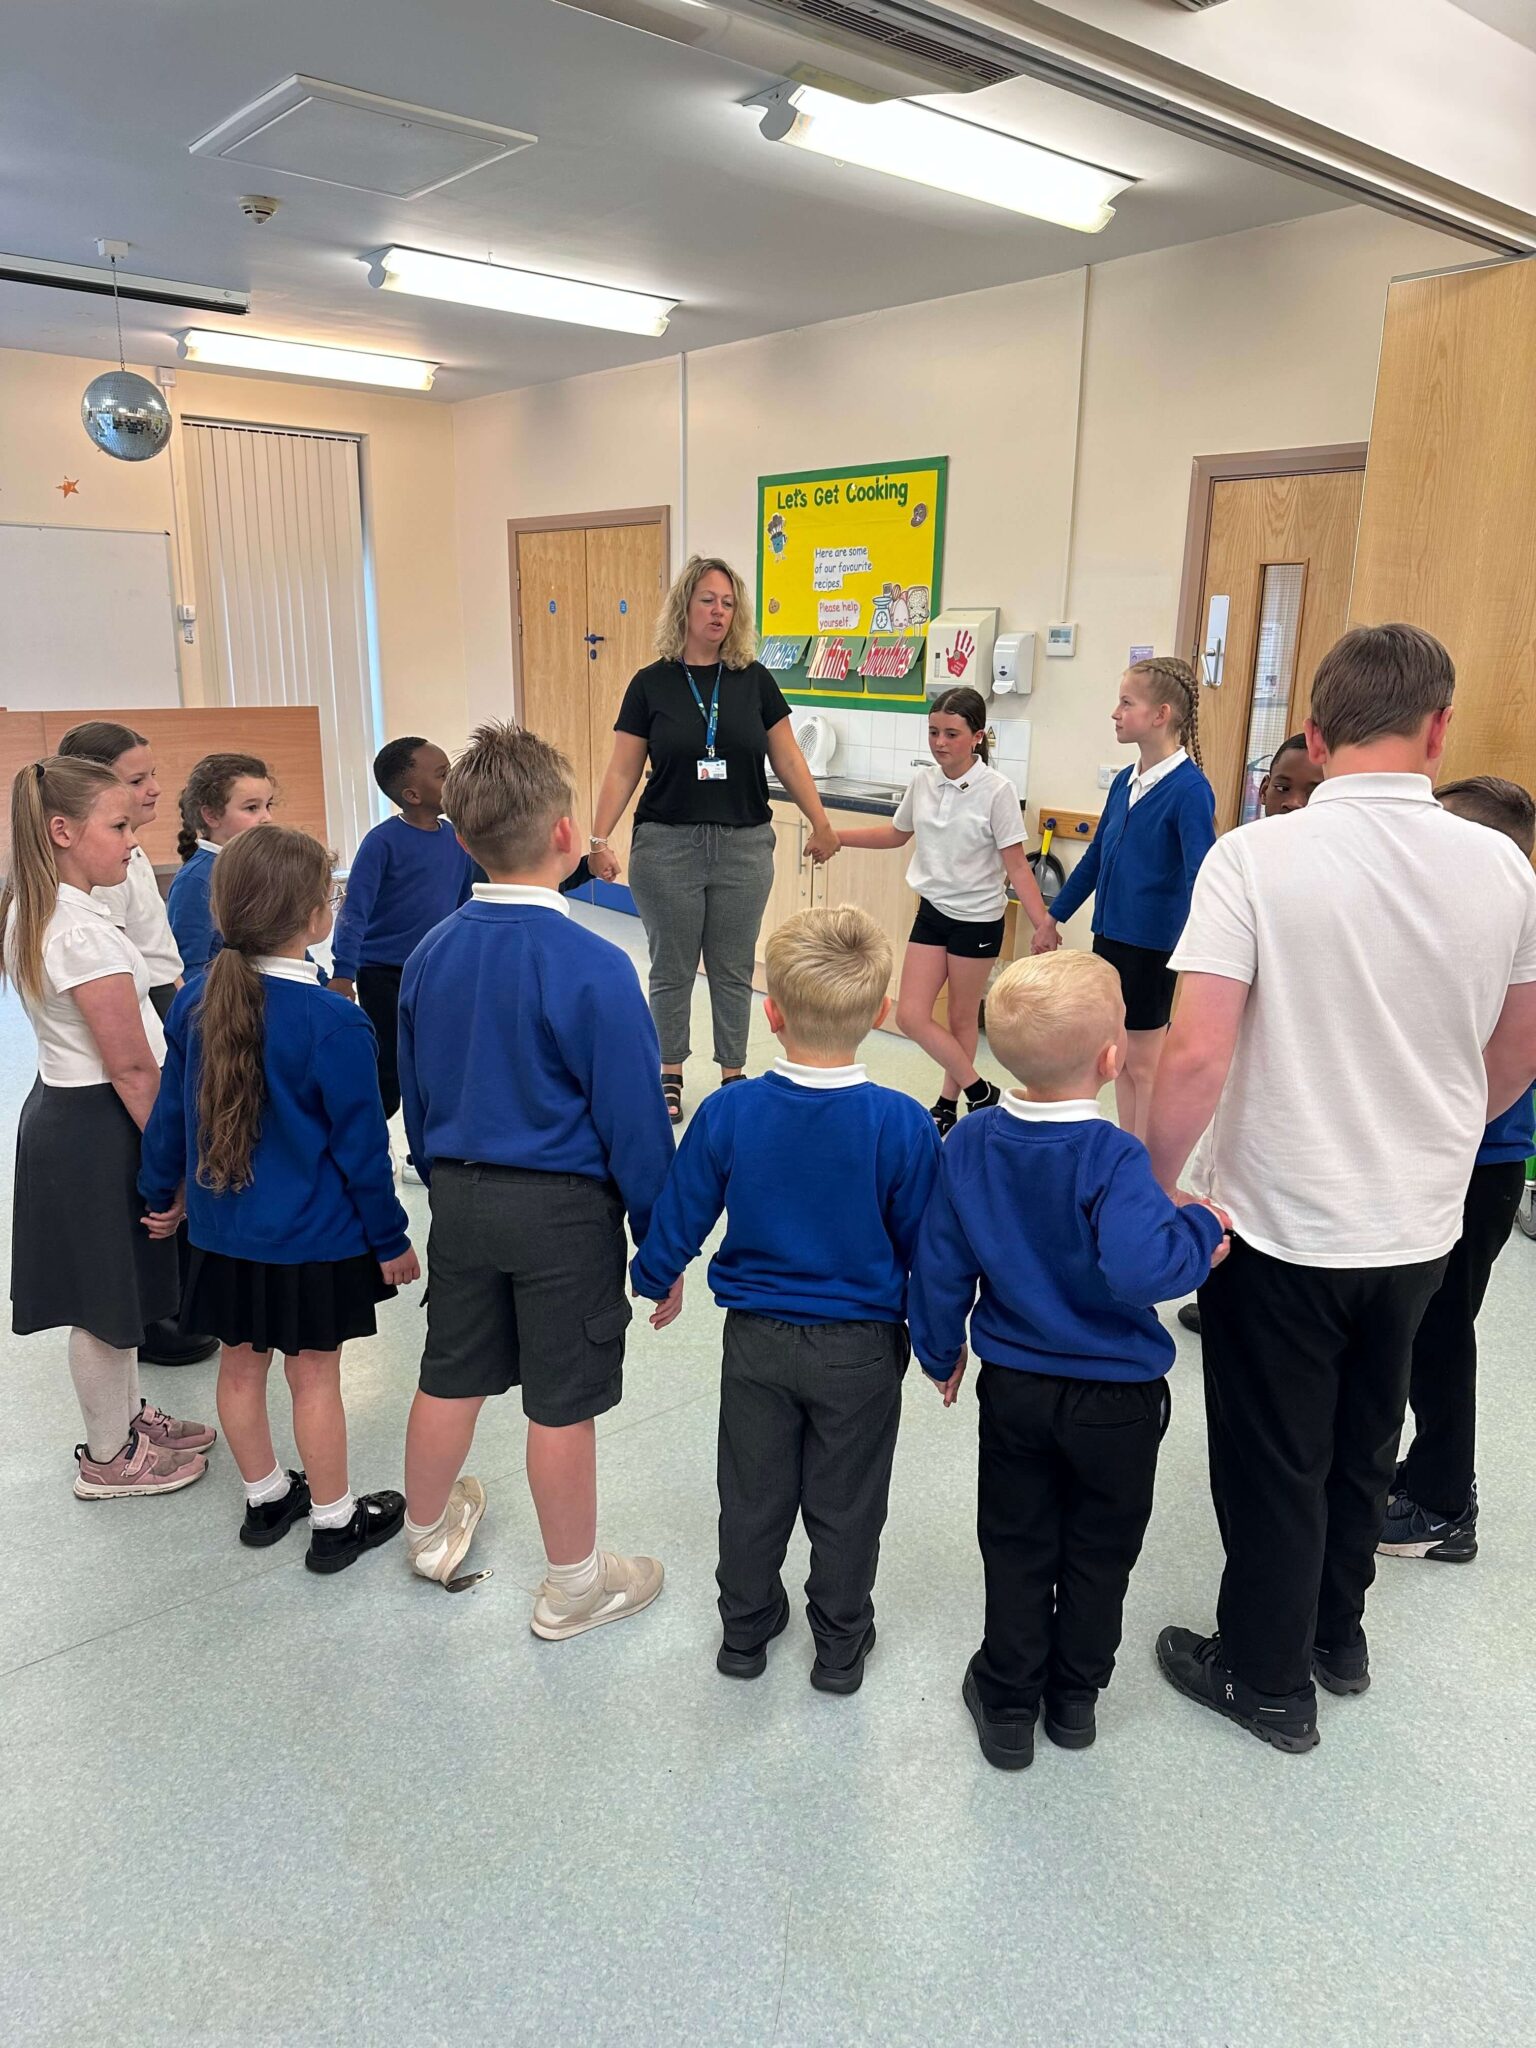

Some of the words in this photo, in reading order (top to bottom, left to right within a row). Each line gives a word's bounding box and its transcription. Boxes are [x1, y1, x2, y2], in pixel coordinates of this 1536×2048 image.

[777, 488, 808, 510] Let's
[814, 484, 840, 506] Get
[846, 476, 909, 507] Cooking
[815, 548, 834, 559] Here
[834, 549, 848, 558] are
[848, 547, 868, 557] some
[814, 562, 823, 574] of
[824, 564, 837, 573] our
[838, 561, 873, 573] favourite
[814, 579, 842, 590] recipes.
[819, 602, 841, 613] Please
[841, 601, 859, 614] help
[819, 616, 852, 630] yourself.
[806, 636, 853, 680] Muffins
[858, 636, 915, 678] Smoothies
